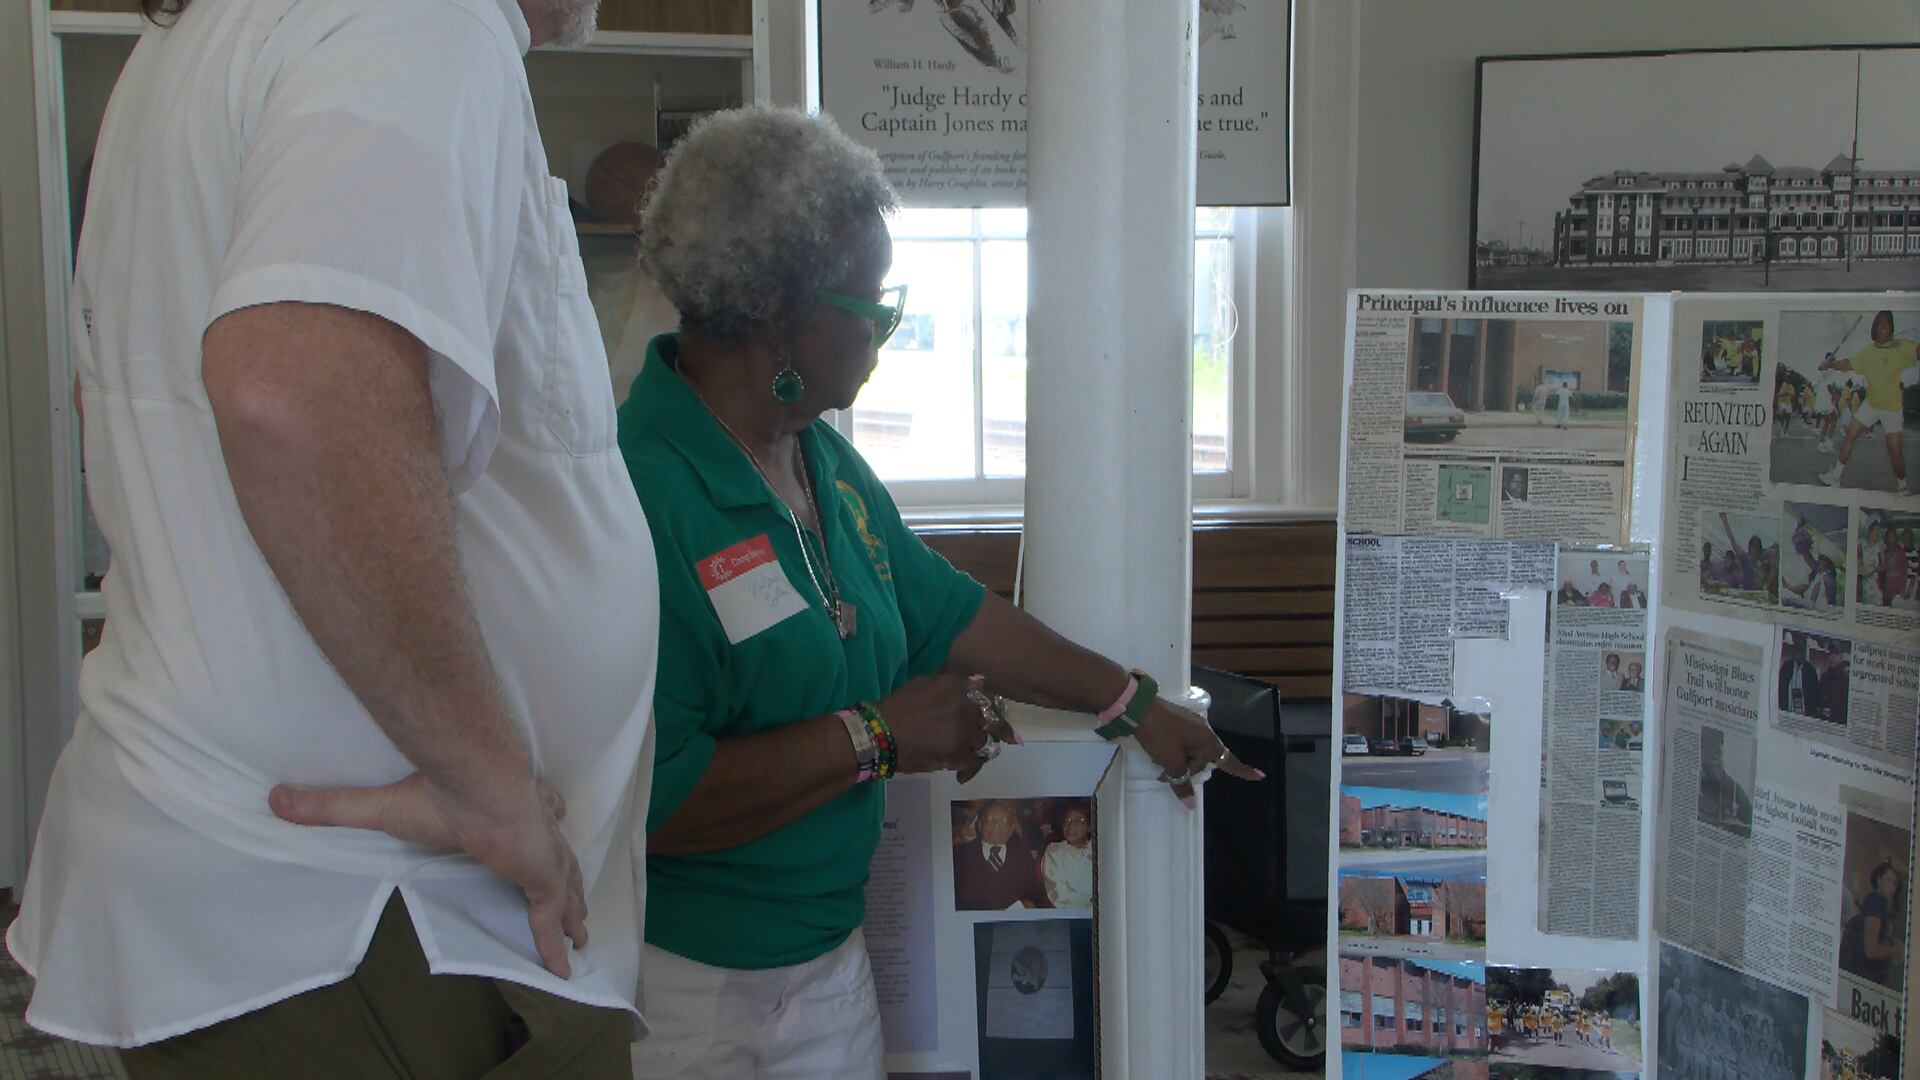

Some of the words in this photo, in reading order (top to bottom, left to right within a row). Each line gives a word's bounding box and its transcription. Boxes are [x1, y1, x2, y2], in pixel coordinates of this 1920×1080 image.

[873, 58, 909, 70] William
[912, 58, 925, 70] H.
[927, 58, 956, 73] Hardy
[882, 85, 946, 112] "Judge
[952, 86, 1013, 112] Hardy
[1210, 86, 1244, 106] and
[861, 112, 937, 137] Captain
[943, 112, 994, 136] Jones
[1001, 117, 1027, 131] ma
[1218, 112, 1268, 132] true."
[917, 150, 928, 163] of
[928, 149, 970, 163] Gulfport's
[971, 149, 1011, 164] founding
[910, 164, 927, 174] and
[927, 163, 968, 177] publisher
[969, 164, 981, 177] of
[993, 163, 1017, 175] books
[906, 178, 917, 190] by
[919, 177, 946, 191] Harry
[1357, 294, 1457, 315] Principal's
[1461, 296, 1550, 314] influence
[1555, 297, 1599, 315] lives
[1603, 302, 1629, 315] on
[1683, 401, 1766, 427] REUNITED
[1697, 430, 1749, 456] AGAIN
[1601, 631, 1619, 641] High
[1620, 632, 1645, 641] School
[1683, 653, 1729, 677] Mississippi
[1731, 665, 1755, 683] Blues
[1866, 659, 1886, 670] work
[1685, 671, 1704, 688] Trail
[1706, 678, 1723, 693] will
[1724, 681, 1751, 700] honor
[1676, 686, 1713, 707] Gulfport
[1715, 699, 1759, 721] musicians
[1851, 987, 1889, 1031] Back
